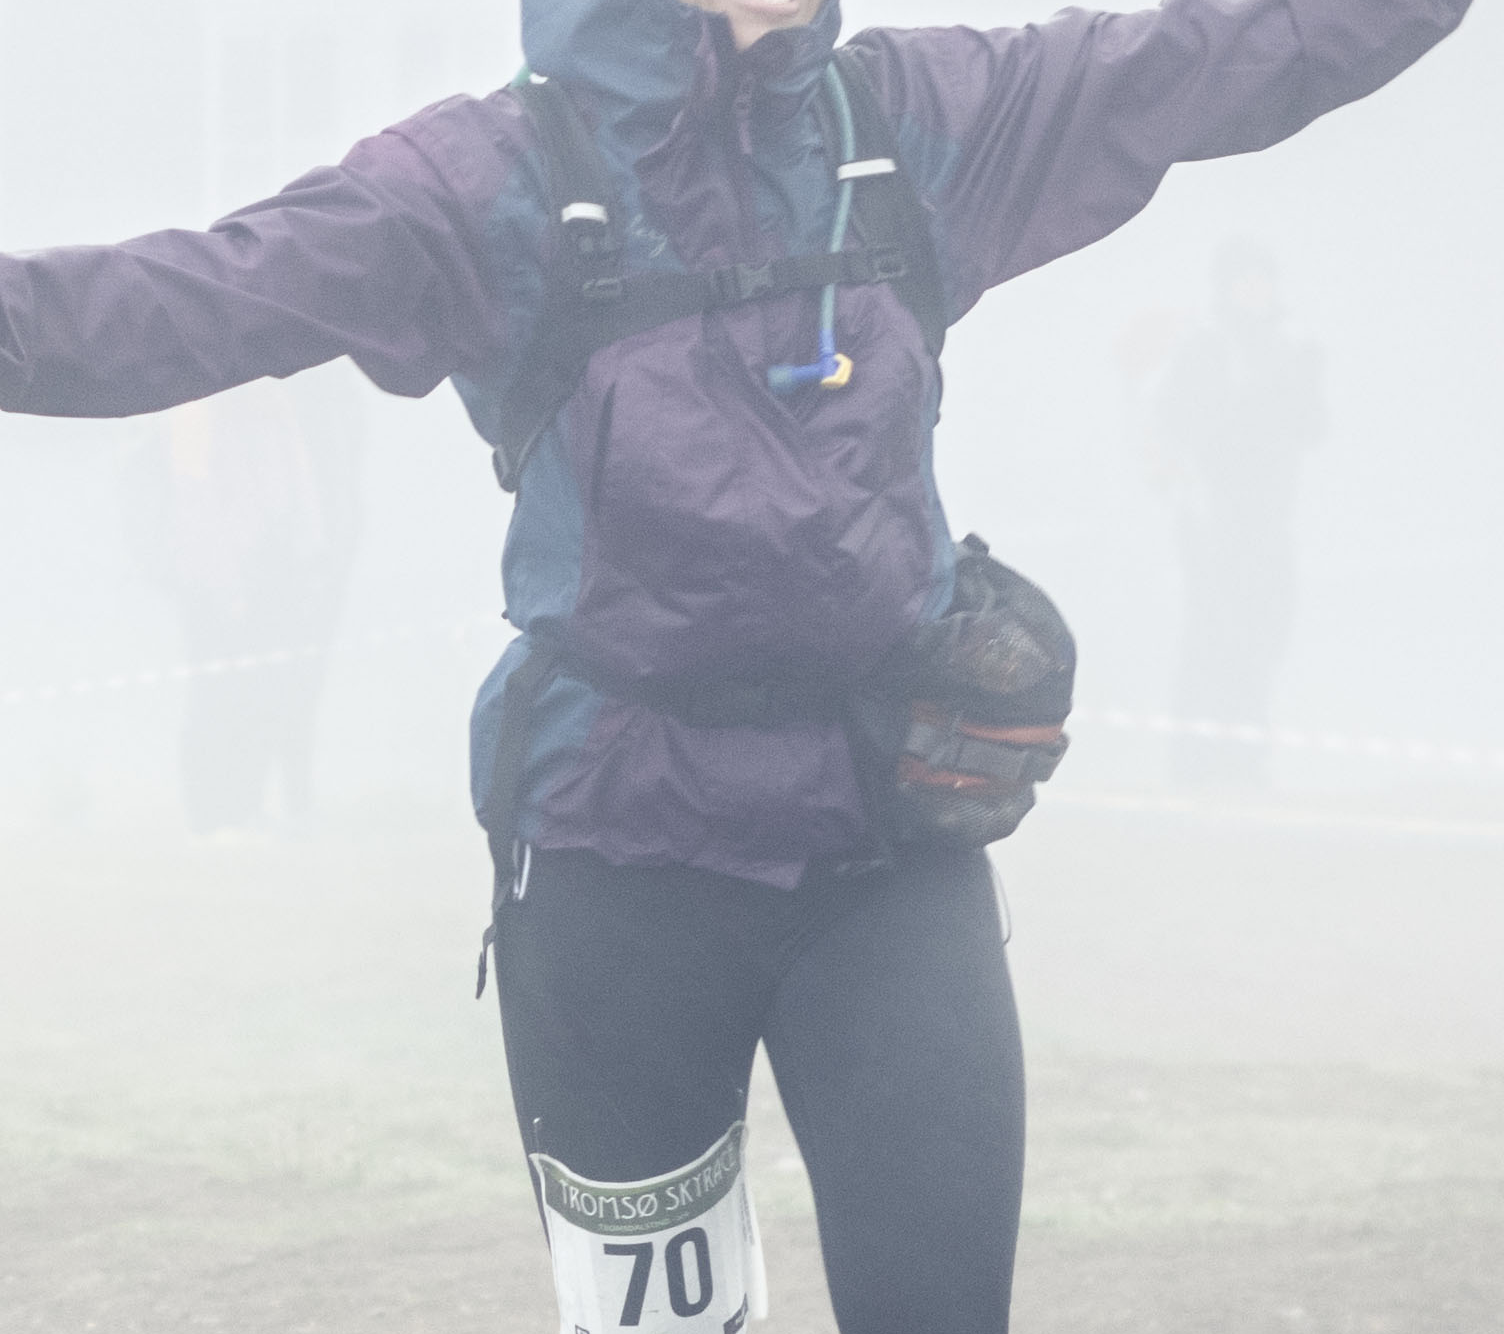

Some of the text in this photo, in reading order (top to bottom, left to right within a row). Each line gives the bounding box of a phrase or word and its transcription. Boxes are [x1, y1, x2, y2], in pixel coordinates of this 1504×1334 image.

[559, 1144, 736, 1219] TROMSØ SKYRACE
[603, 1226, 714, 1327] 70
